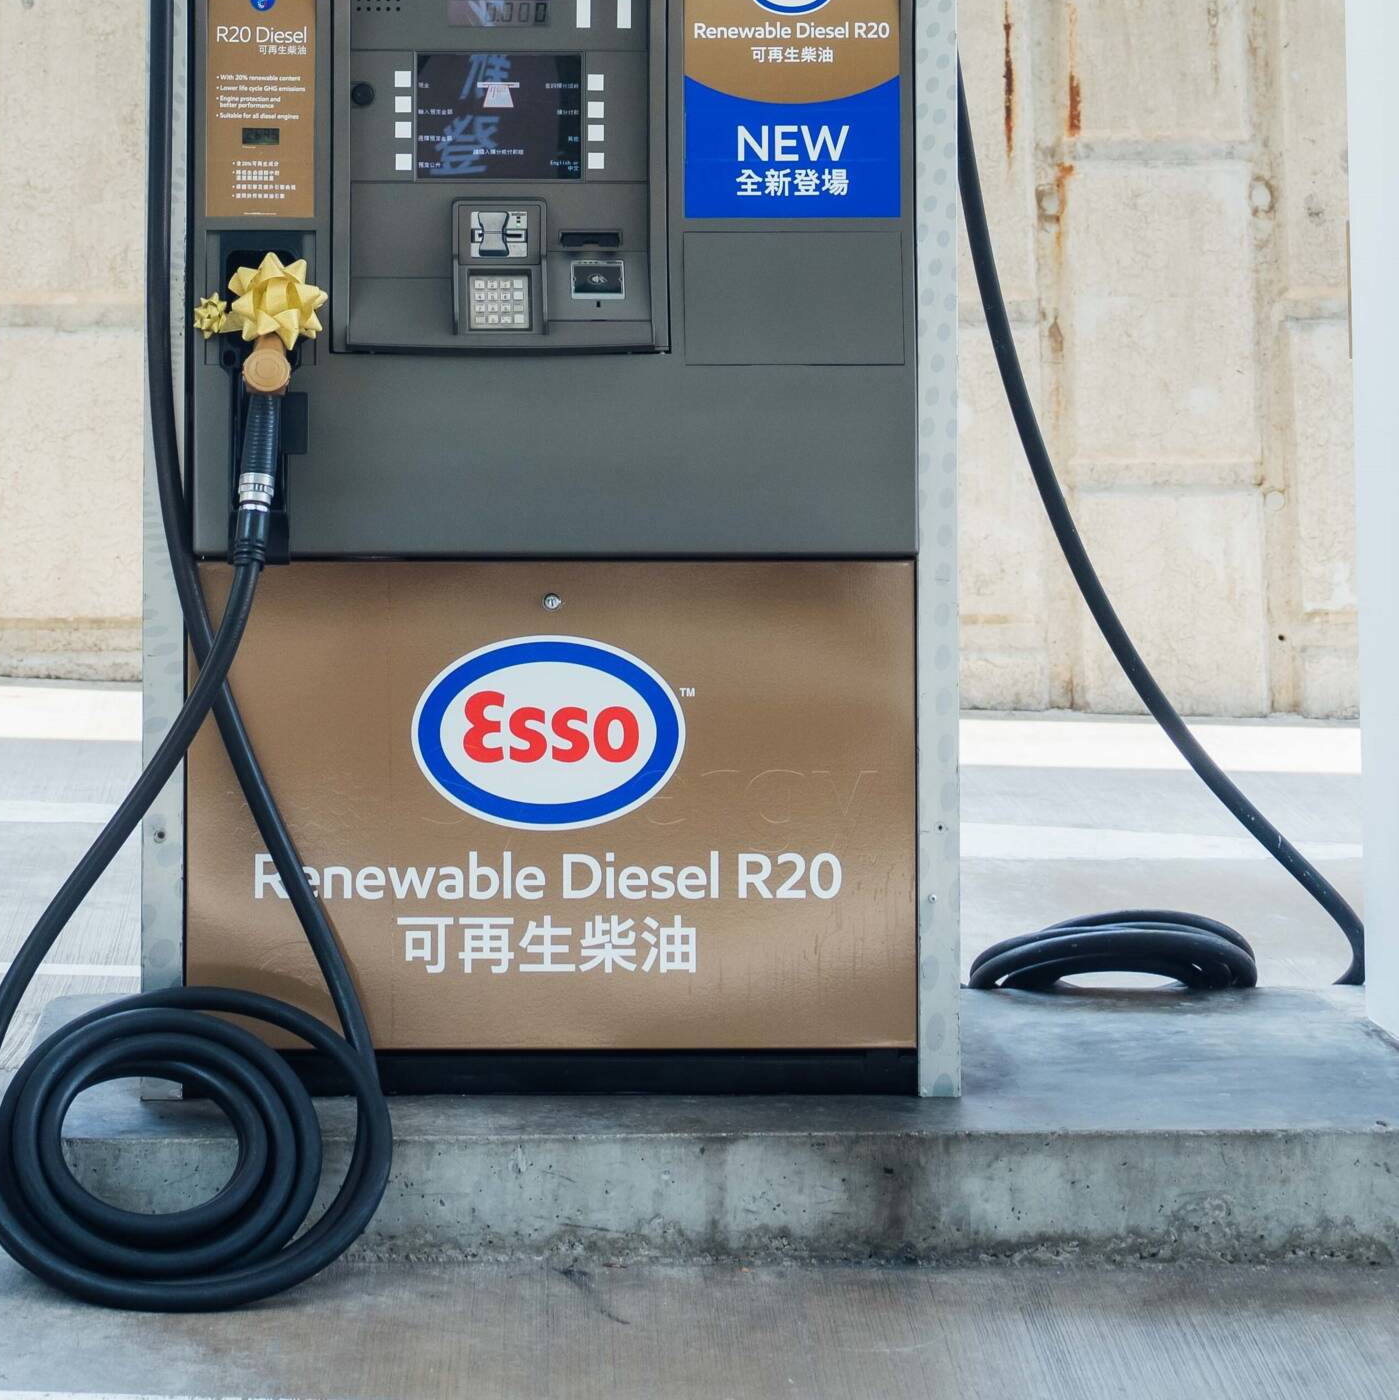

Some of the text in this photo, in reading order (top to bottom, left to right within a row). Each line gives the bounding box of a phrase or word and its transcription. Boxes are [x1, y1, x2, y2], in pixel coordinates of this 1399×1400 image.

[216, 26, 307, 43] R20 Diesel
[694, 21, 890, 39] Renewable Diesel R20
[258, 44, 307, 55] 可再生柴油
[750, 46, 834, 63] 可再生柴油
[737, 125, 850, 162] NEW
[735, 168, 850, 197] 全新登場
[462, 690, 640, 764] Esso
[562, 850, 720, 900] Diesel
[737, 852, 843, 900] R20
[396, 914, 697, 974] 可再生柴油
